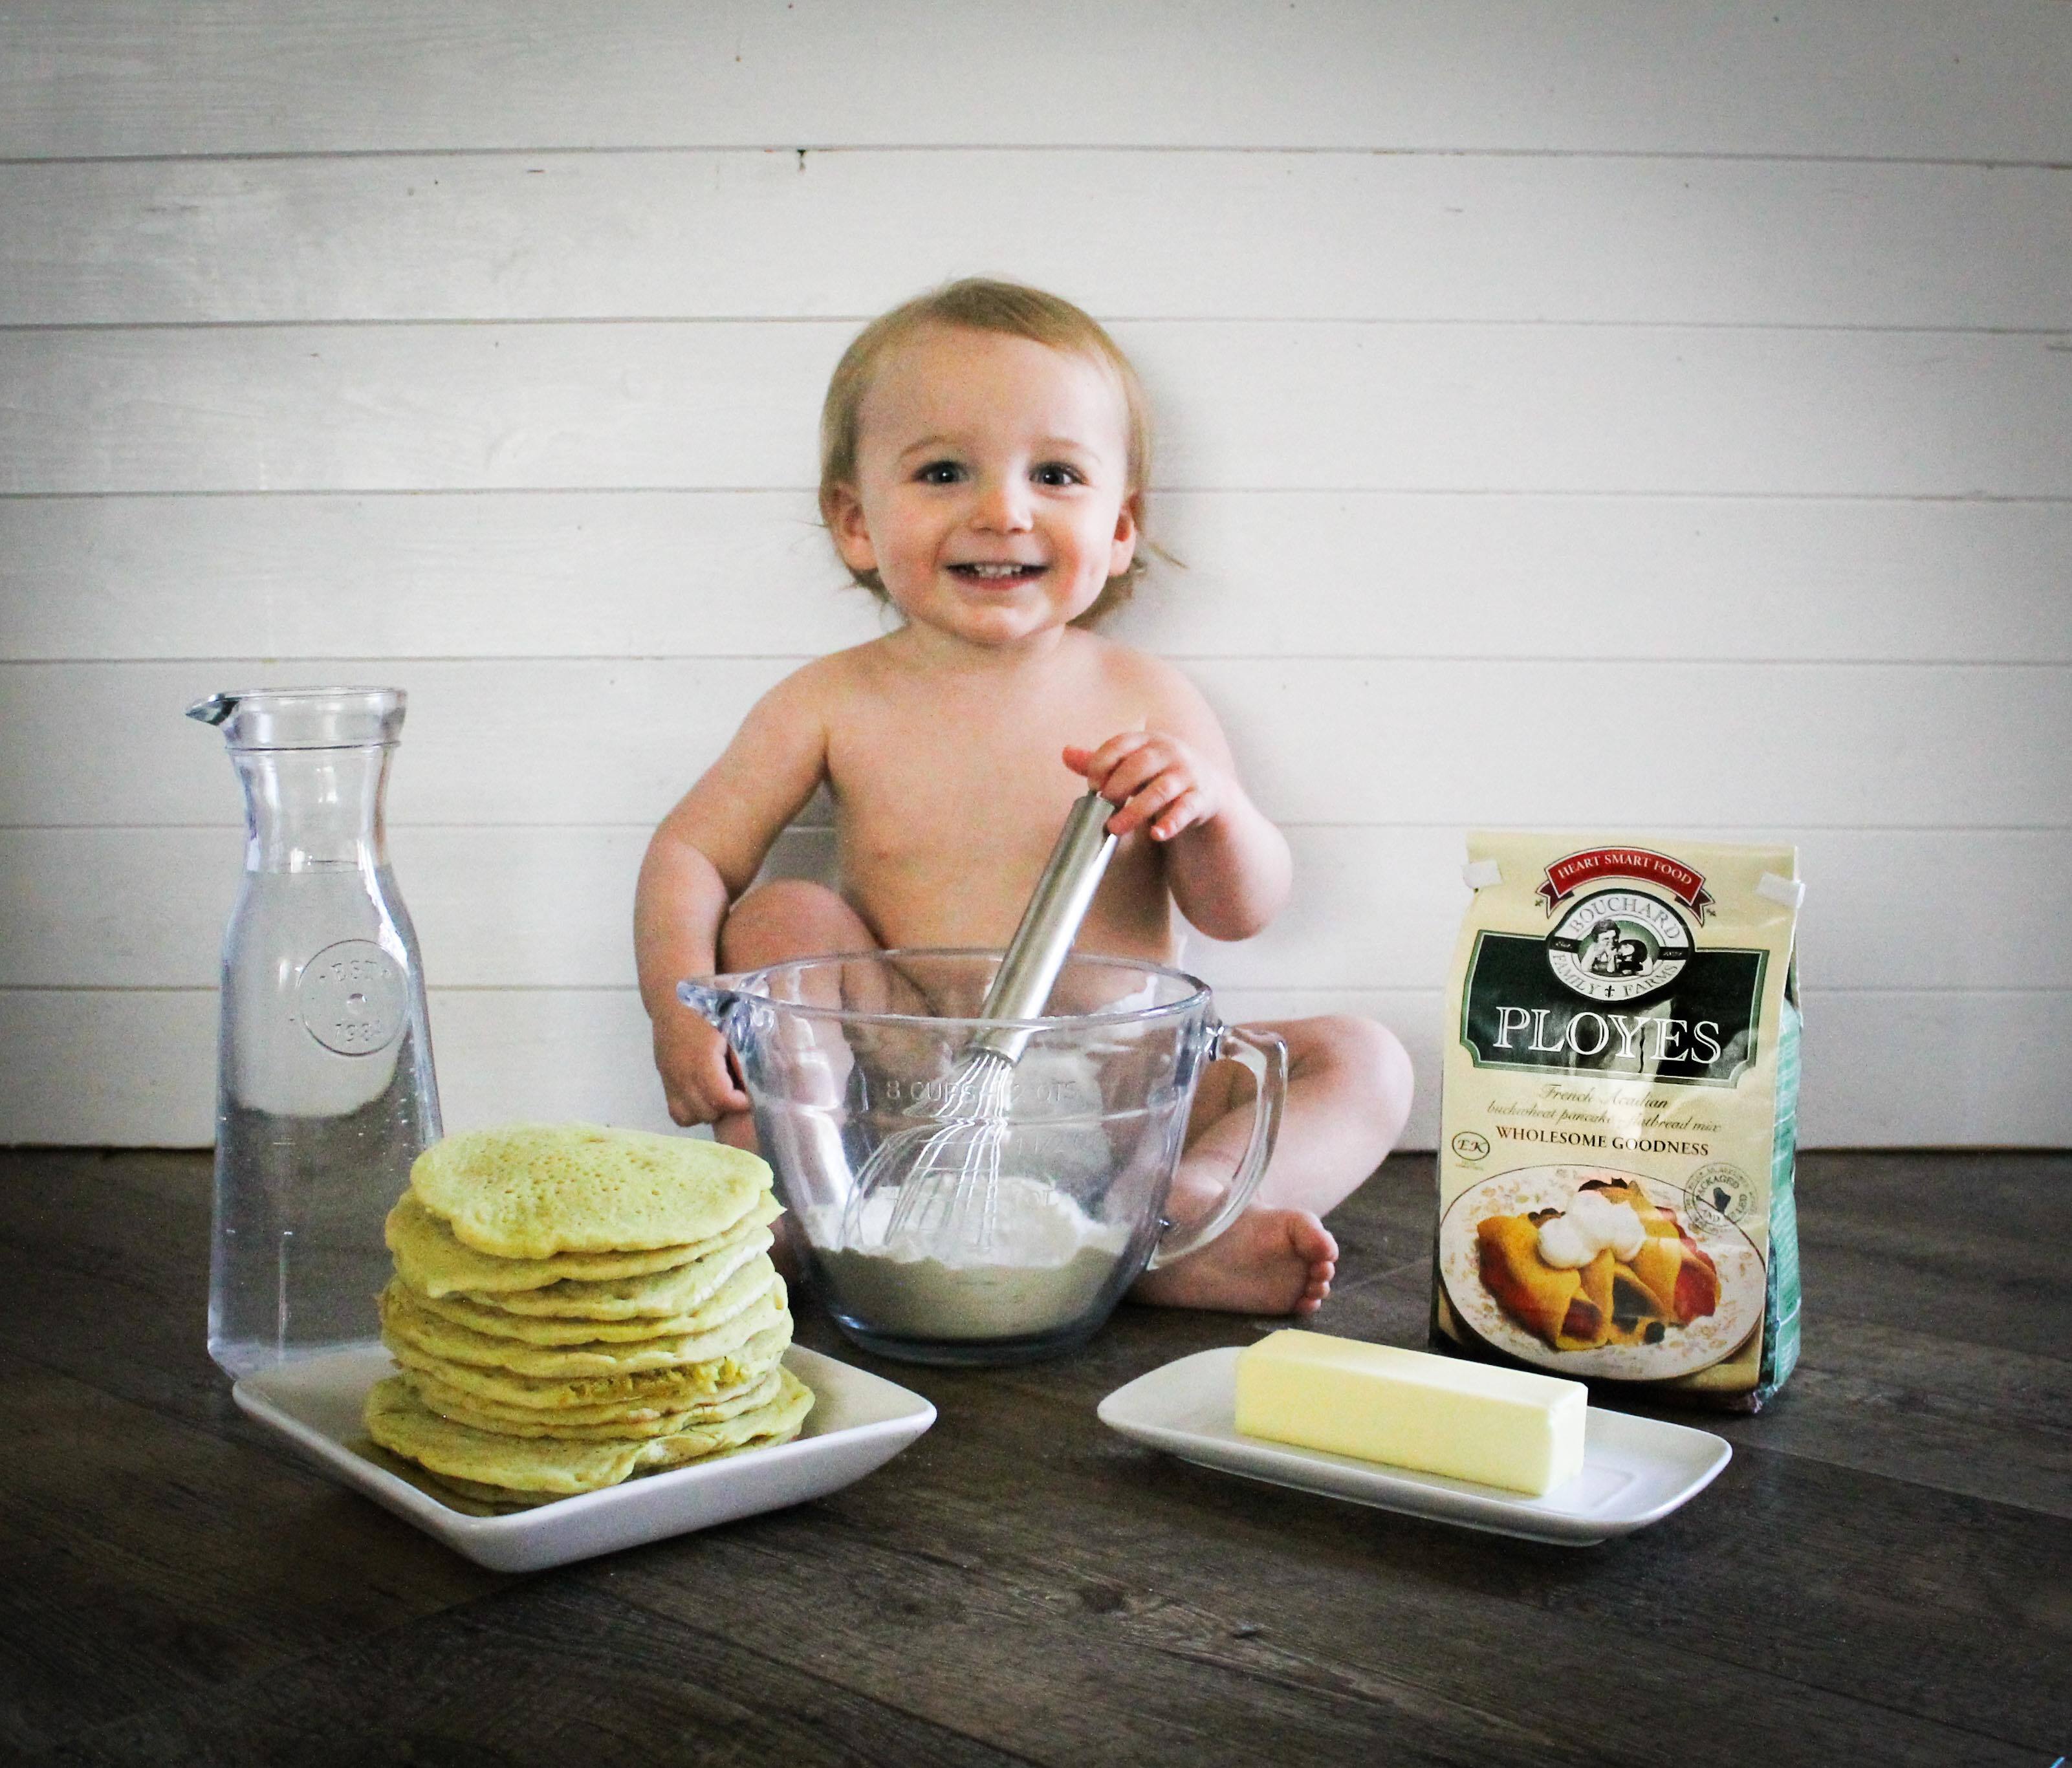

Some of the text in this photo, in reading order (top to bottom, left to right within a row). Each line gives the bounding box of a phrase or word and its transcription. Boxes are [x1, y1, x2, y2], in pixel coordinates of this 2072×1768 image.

[1558, 854, 1692, 885] HEART SMART FOOD
[1570, 897, 1680, 939] BOUCHARD
[1553, 953, 1678, 997] FAMILY FARMS
[1492, 1006, 1721, 1064] PLOYES
[1536, 1084, 1596, 1102] French
[1496, 1126, 1709, 1156] WHOLESOME GOODNESS
[1692, 1120, 1722, 1133] mix
